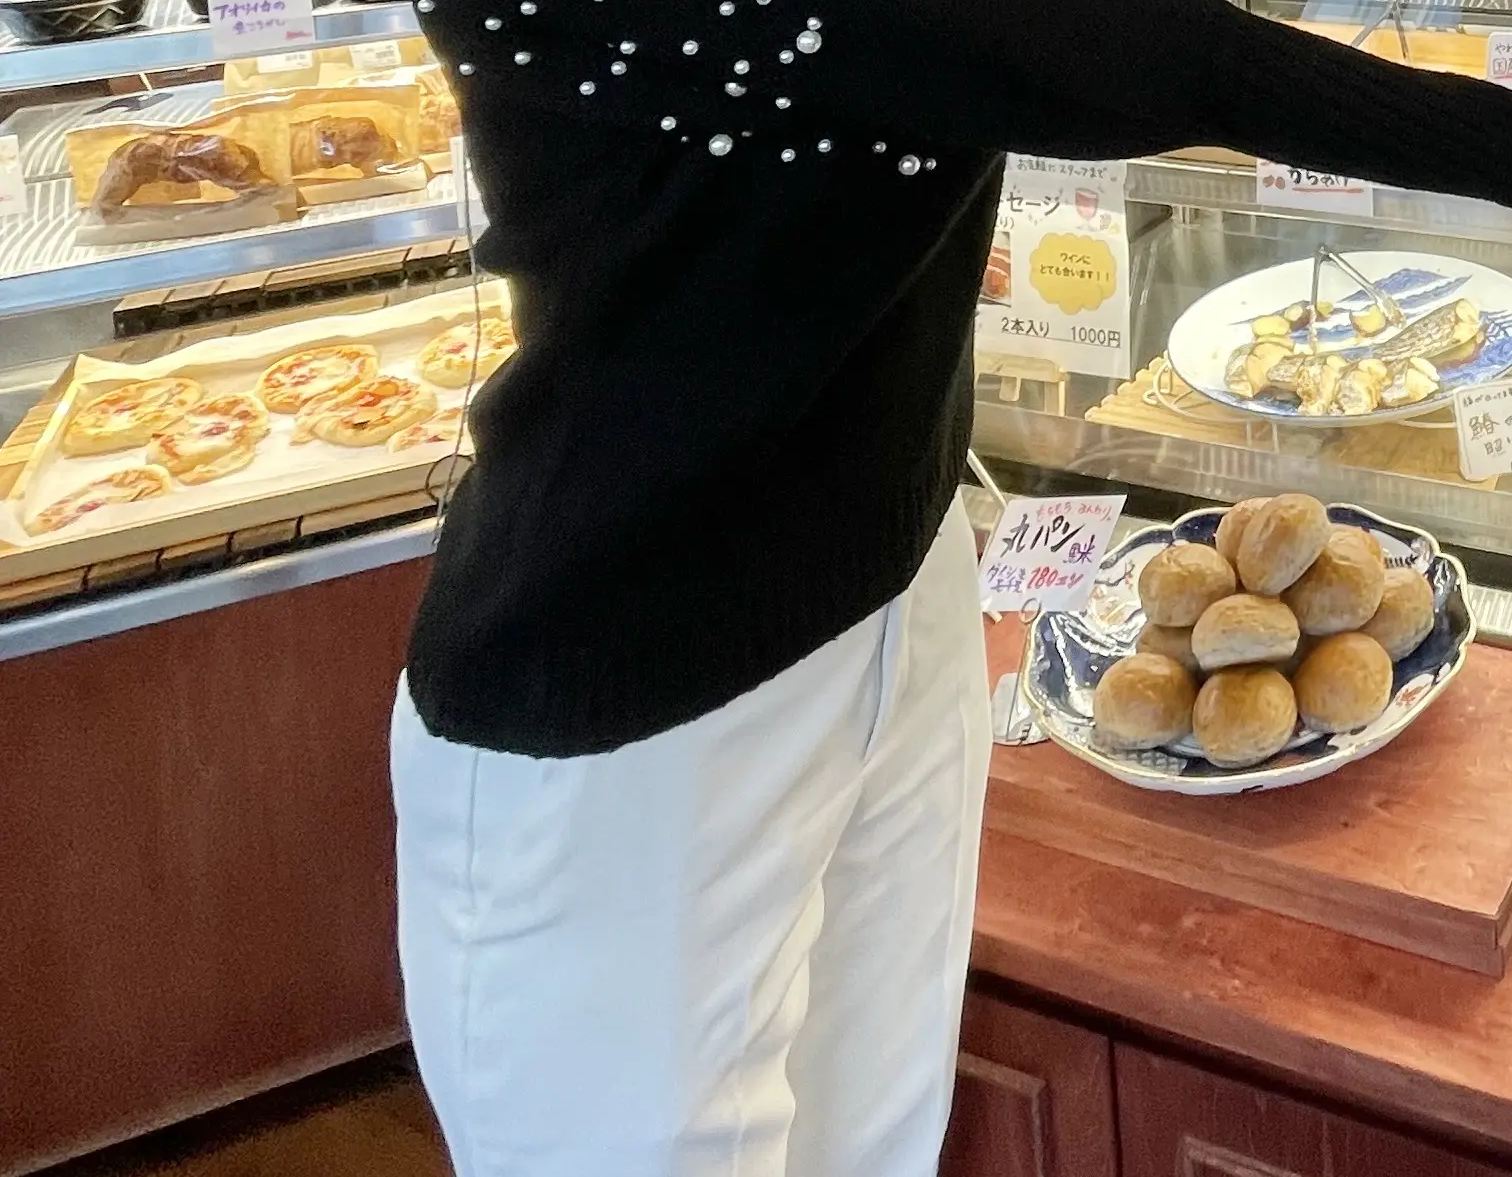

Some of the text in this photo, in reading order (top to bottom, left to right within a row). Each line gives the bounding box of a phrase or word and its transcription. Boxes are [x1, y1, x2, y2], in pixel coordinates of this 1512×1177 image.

[212, 0, 286, 20] アオリイカの
[999, 190, 1061, 218] セージ
[1060, 251, 1091, 266] ワインに
[1000, 316, 1121, 348] 2本入り 1000円
[999, 512, 1086, 558] 丸パン
